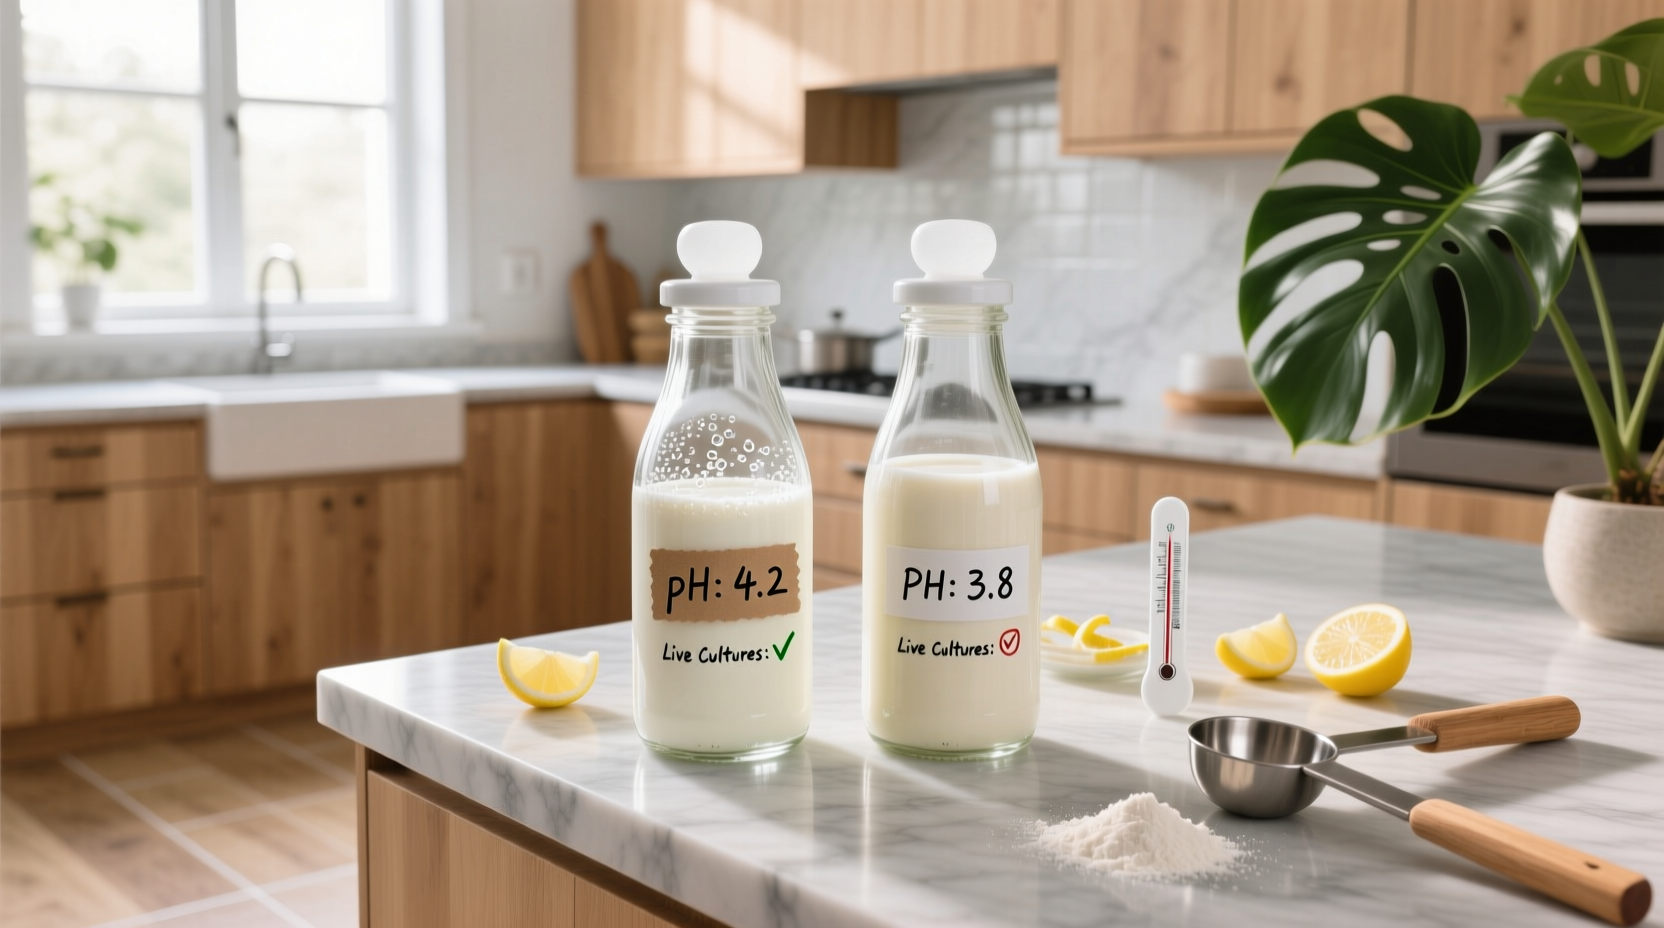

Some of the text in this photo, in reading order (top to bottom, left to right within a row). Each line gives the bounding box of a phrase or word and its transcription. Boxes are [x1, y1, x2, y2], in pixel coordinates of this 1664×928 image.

[666, 565, 788, 615] pH: 4.2
[902, 566, 1013, 601] PH: 3.8
[662, 642, 770, 664] Live Cultures:
[897, 636, 994, 657] Live Cultures:
